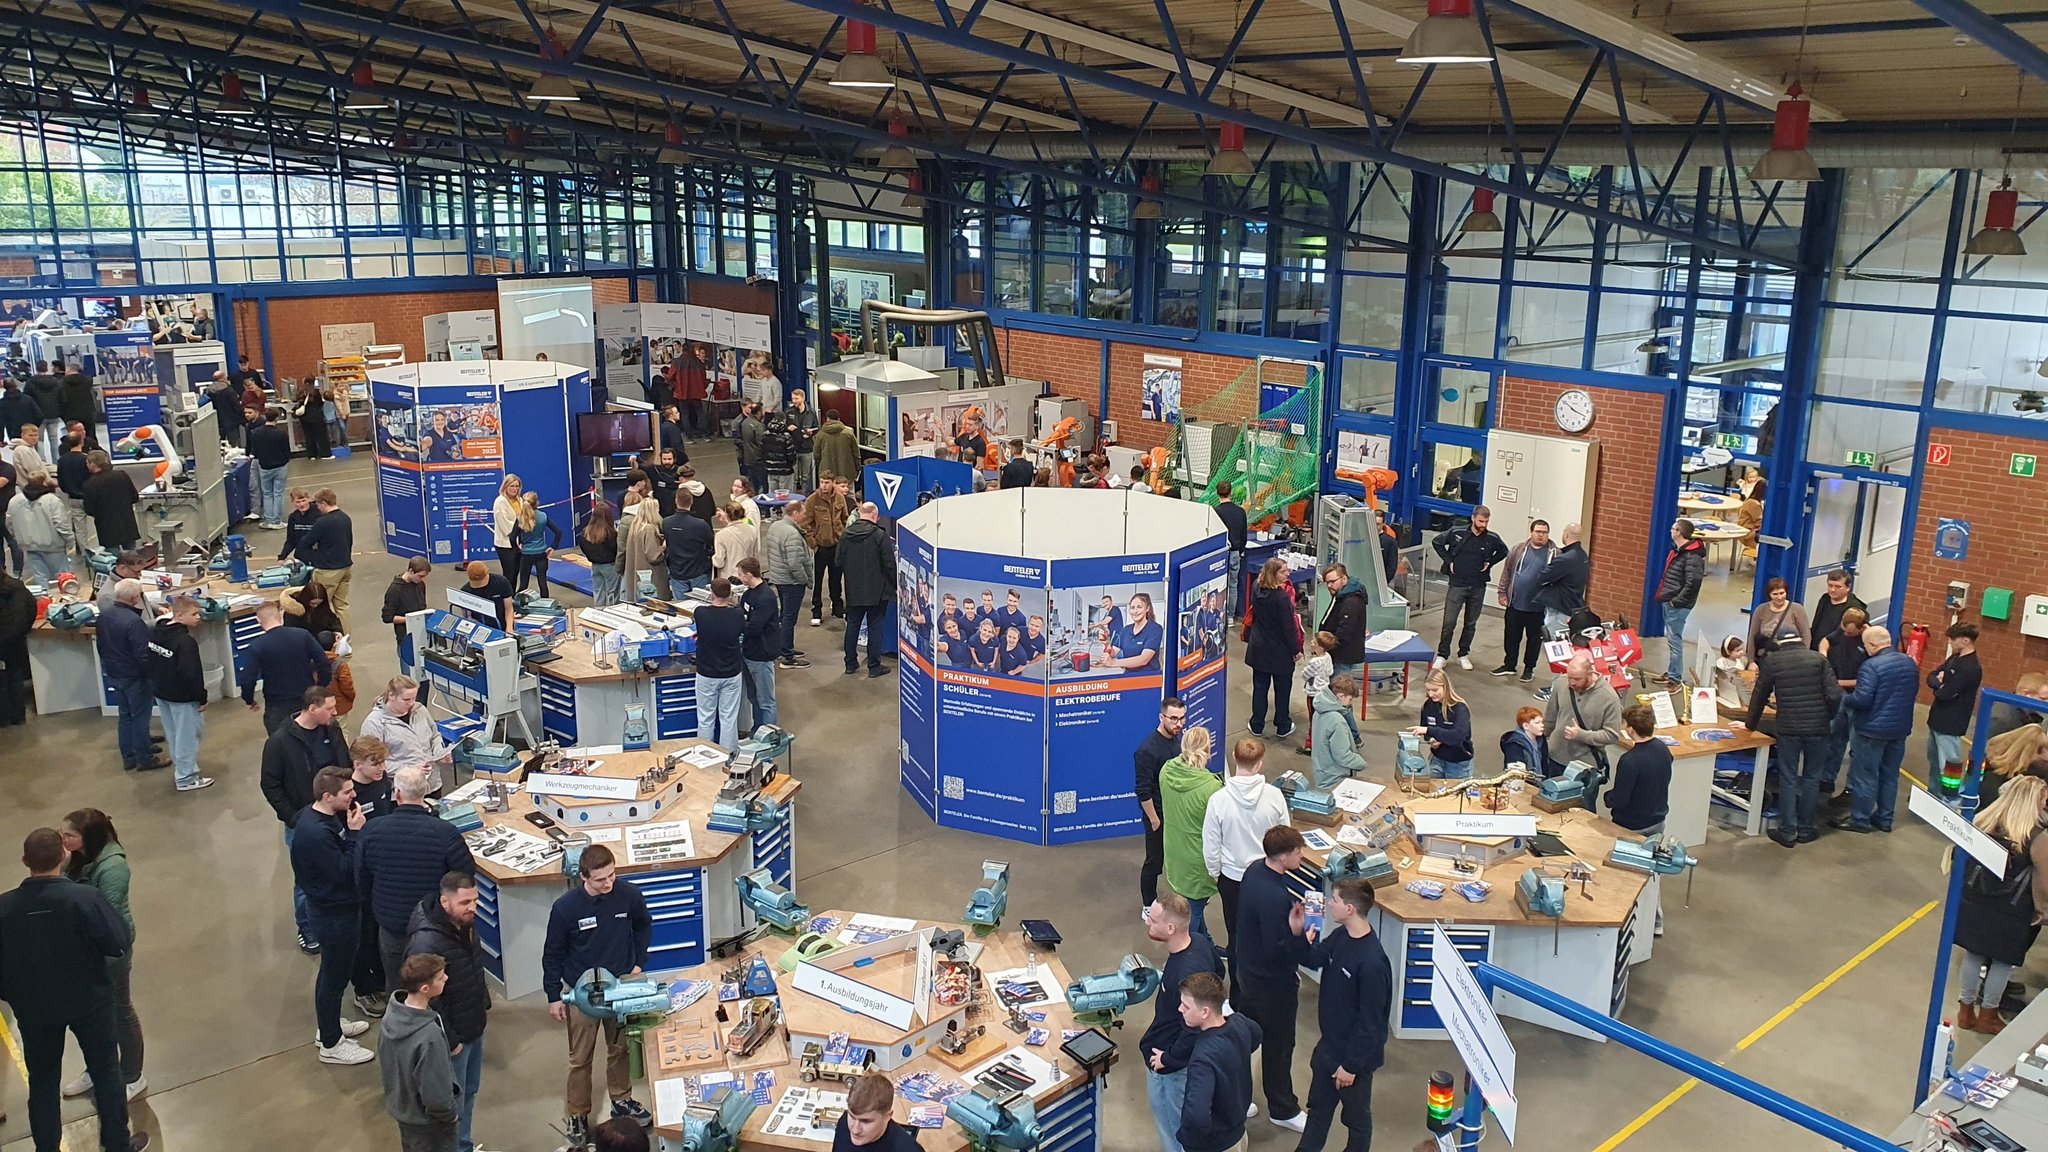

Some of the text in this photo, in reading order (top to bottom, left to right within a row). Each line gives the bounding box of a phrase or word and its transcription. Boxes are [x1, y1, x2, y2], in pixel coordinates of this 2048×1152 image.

[1004, 565, 1034, 575] BENTELER
[1122, 563, 1153, 572] BENTELER
[943, 672, 990, 685] PRAKTIKUM
[943, 684, 979, 696] SCHÜLER
[1056, 682, 1109, 694] AUSBILDUNG
[1055, 693, 1121, 706] ELEKTROBERUFE
[545, 780, 618, 792] Werkzeugmechaniker
[1942, 815, 1974, 846] Praktikum
[1456, 967, 1488, 1026] Elektroniker
[1452, 1012, 1490, 1086] Mechatroniker
